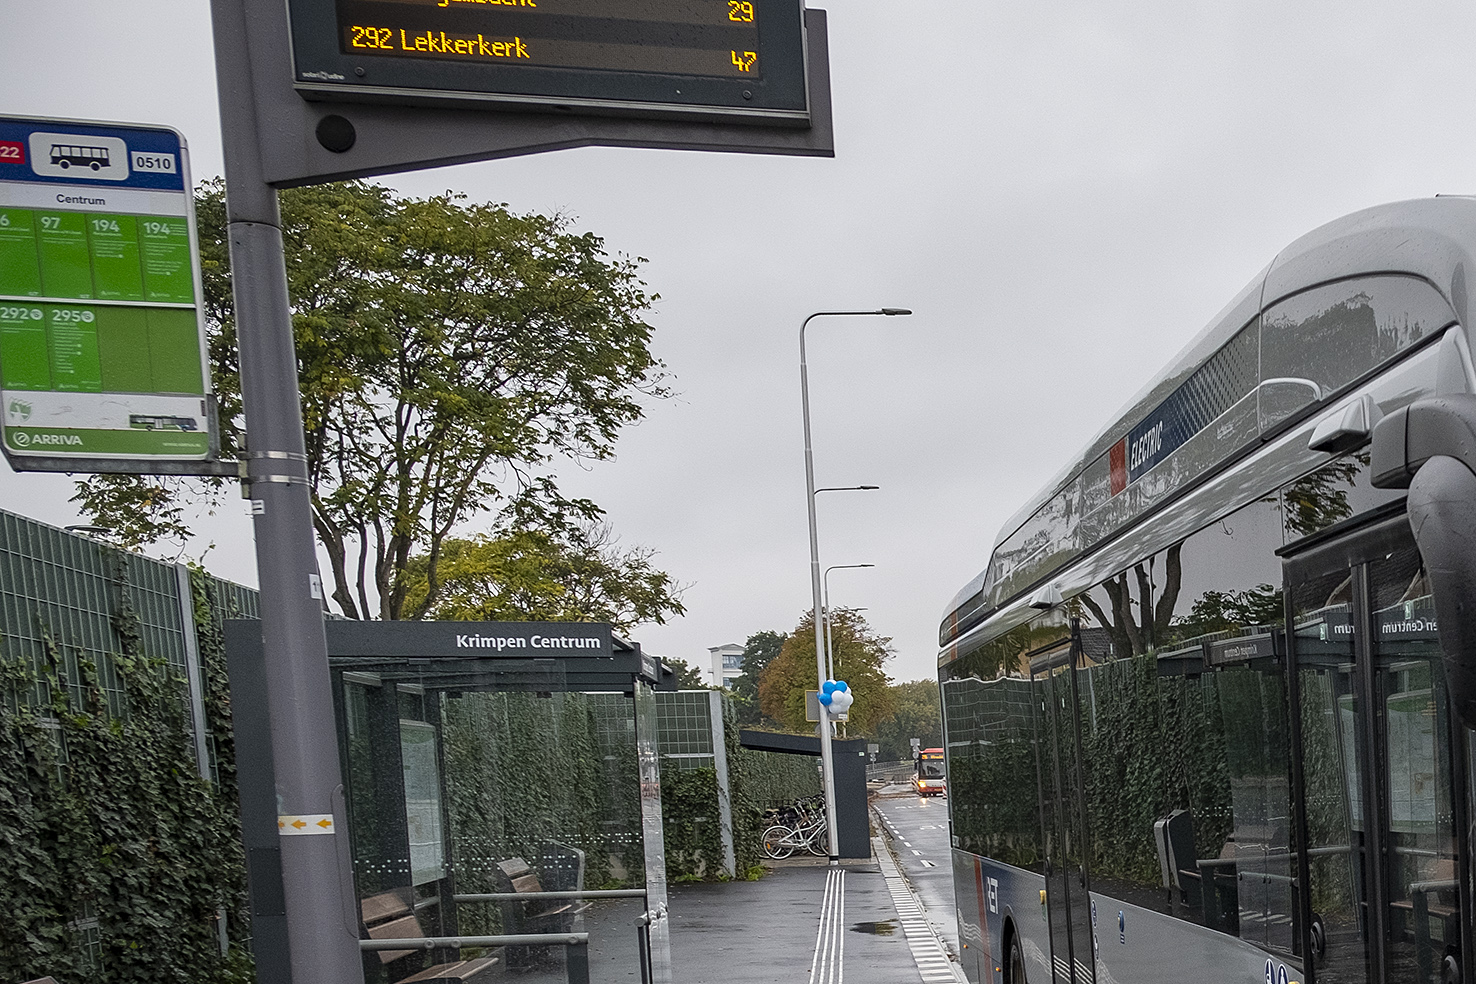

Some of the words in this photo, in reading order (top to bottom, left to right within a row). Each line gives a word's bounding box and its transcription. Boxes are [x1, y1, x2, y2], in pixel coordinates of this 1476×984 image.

[727, 0, 754, 22] 29
[351, 25, 393, 50] 292
[400, 29, 530, 59] Lekkerkerk
[731, 50, 757, 72] 47
[136, 156, 171, 170] 0510
[56, 193, 106, 206] Centrum
[41, 216, 61, 229] 97
[92, 219, 120, 232] 194
[143, 222, 171, 235] 194
[0, 307, 29, 320] 292
[52, 309, 81, 322] 295
[32, 434, 84, 446] ARRIVA
[1130, 420, 1163, 471] ELECTRIC
[456, 634, 526, 651] Krimpen
[530, 635, 600, 648] Centrum
